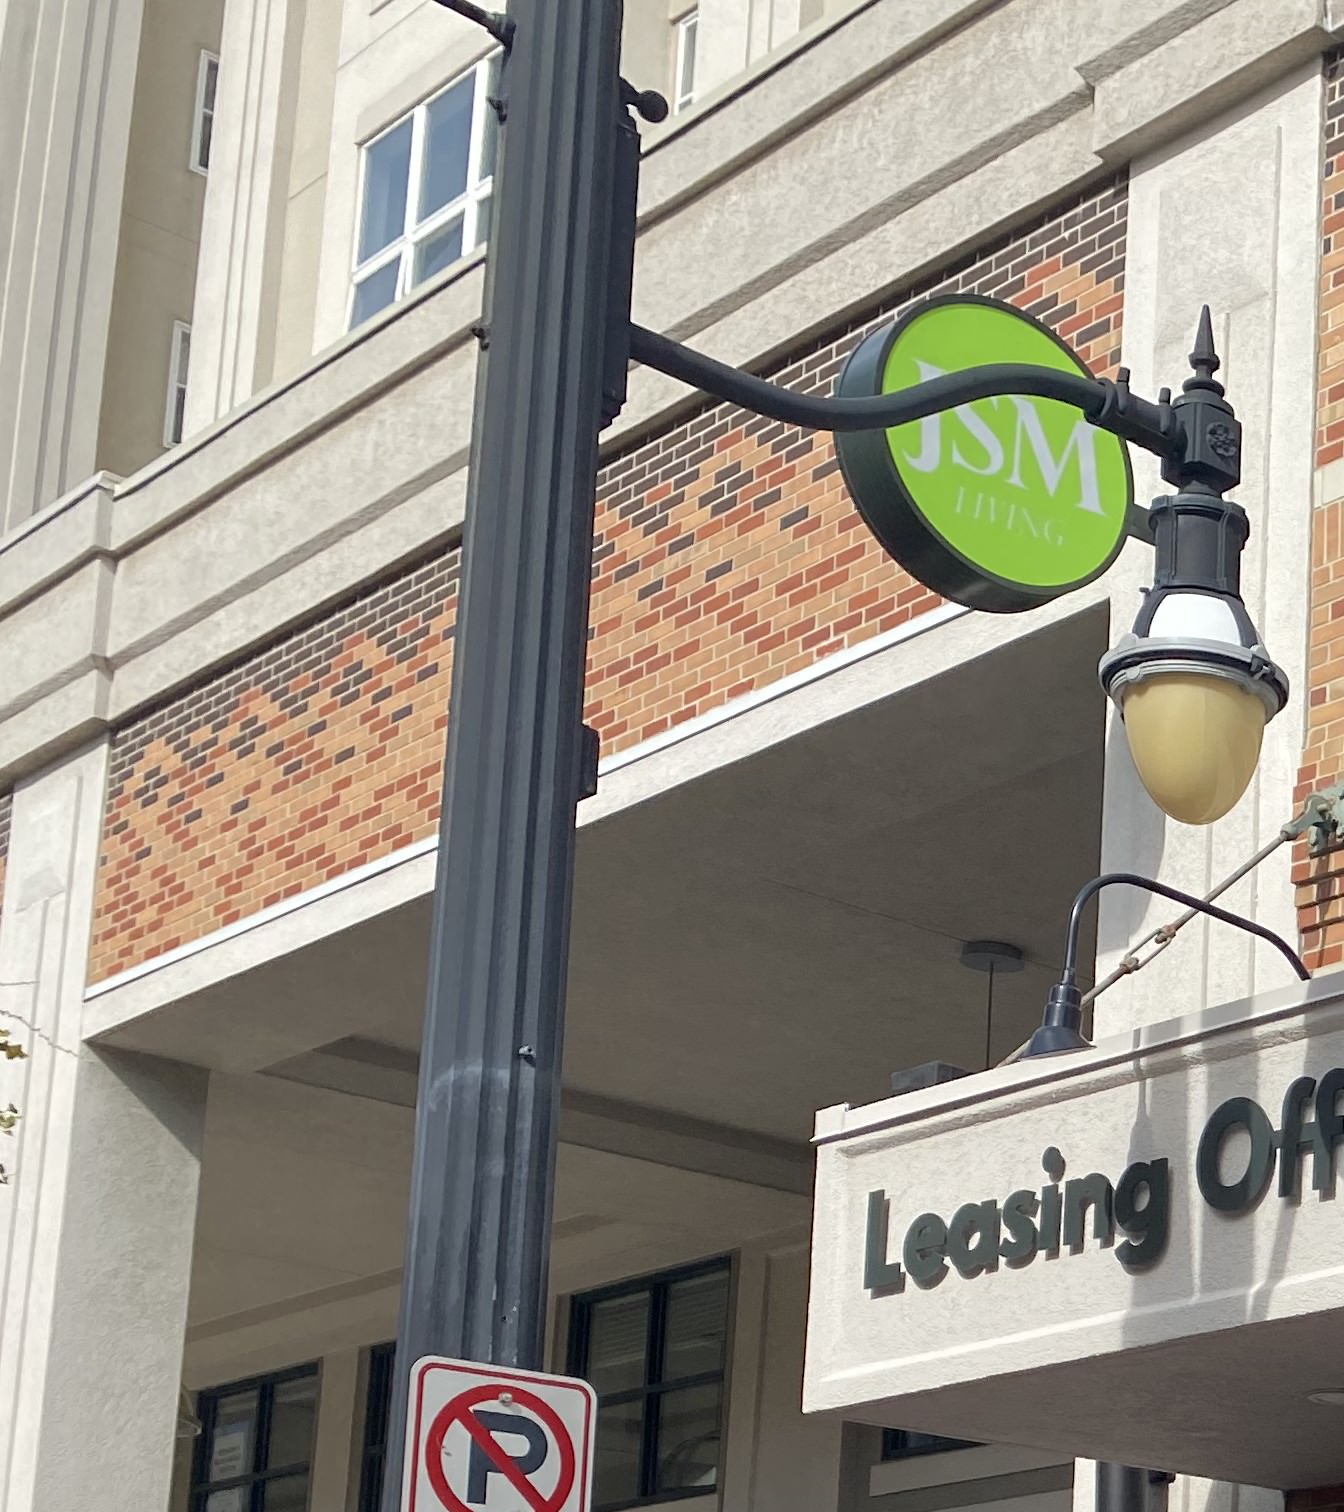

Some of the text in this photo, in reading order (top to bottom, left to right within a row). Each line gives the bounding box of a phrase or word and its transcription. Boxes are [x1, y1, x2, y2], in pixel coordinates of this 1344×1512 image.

[904, 357, 1106, 517] JSM
[954, 485, 1064, 547] LIVING
[863, 1146, 1169, 1269] Leasing
